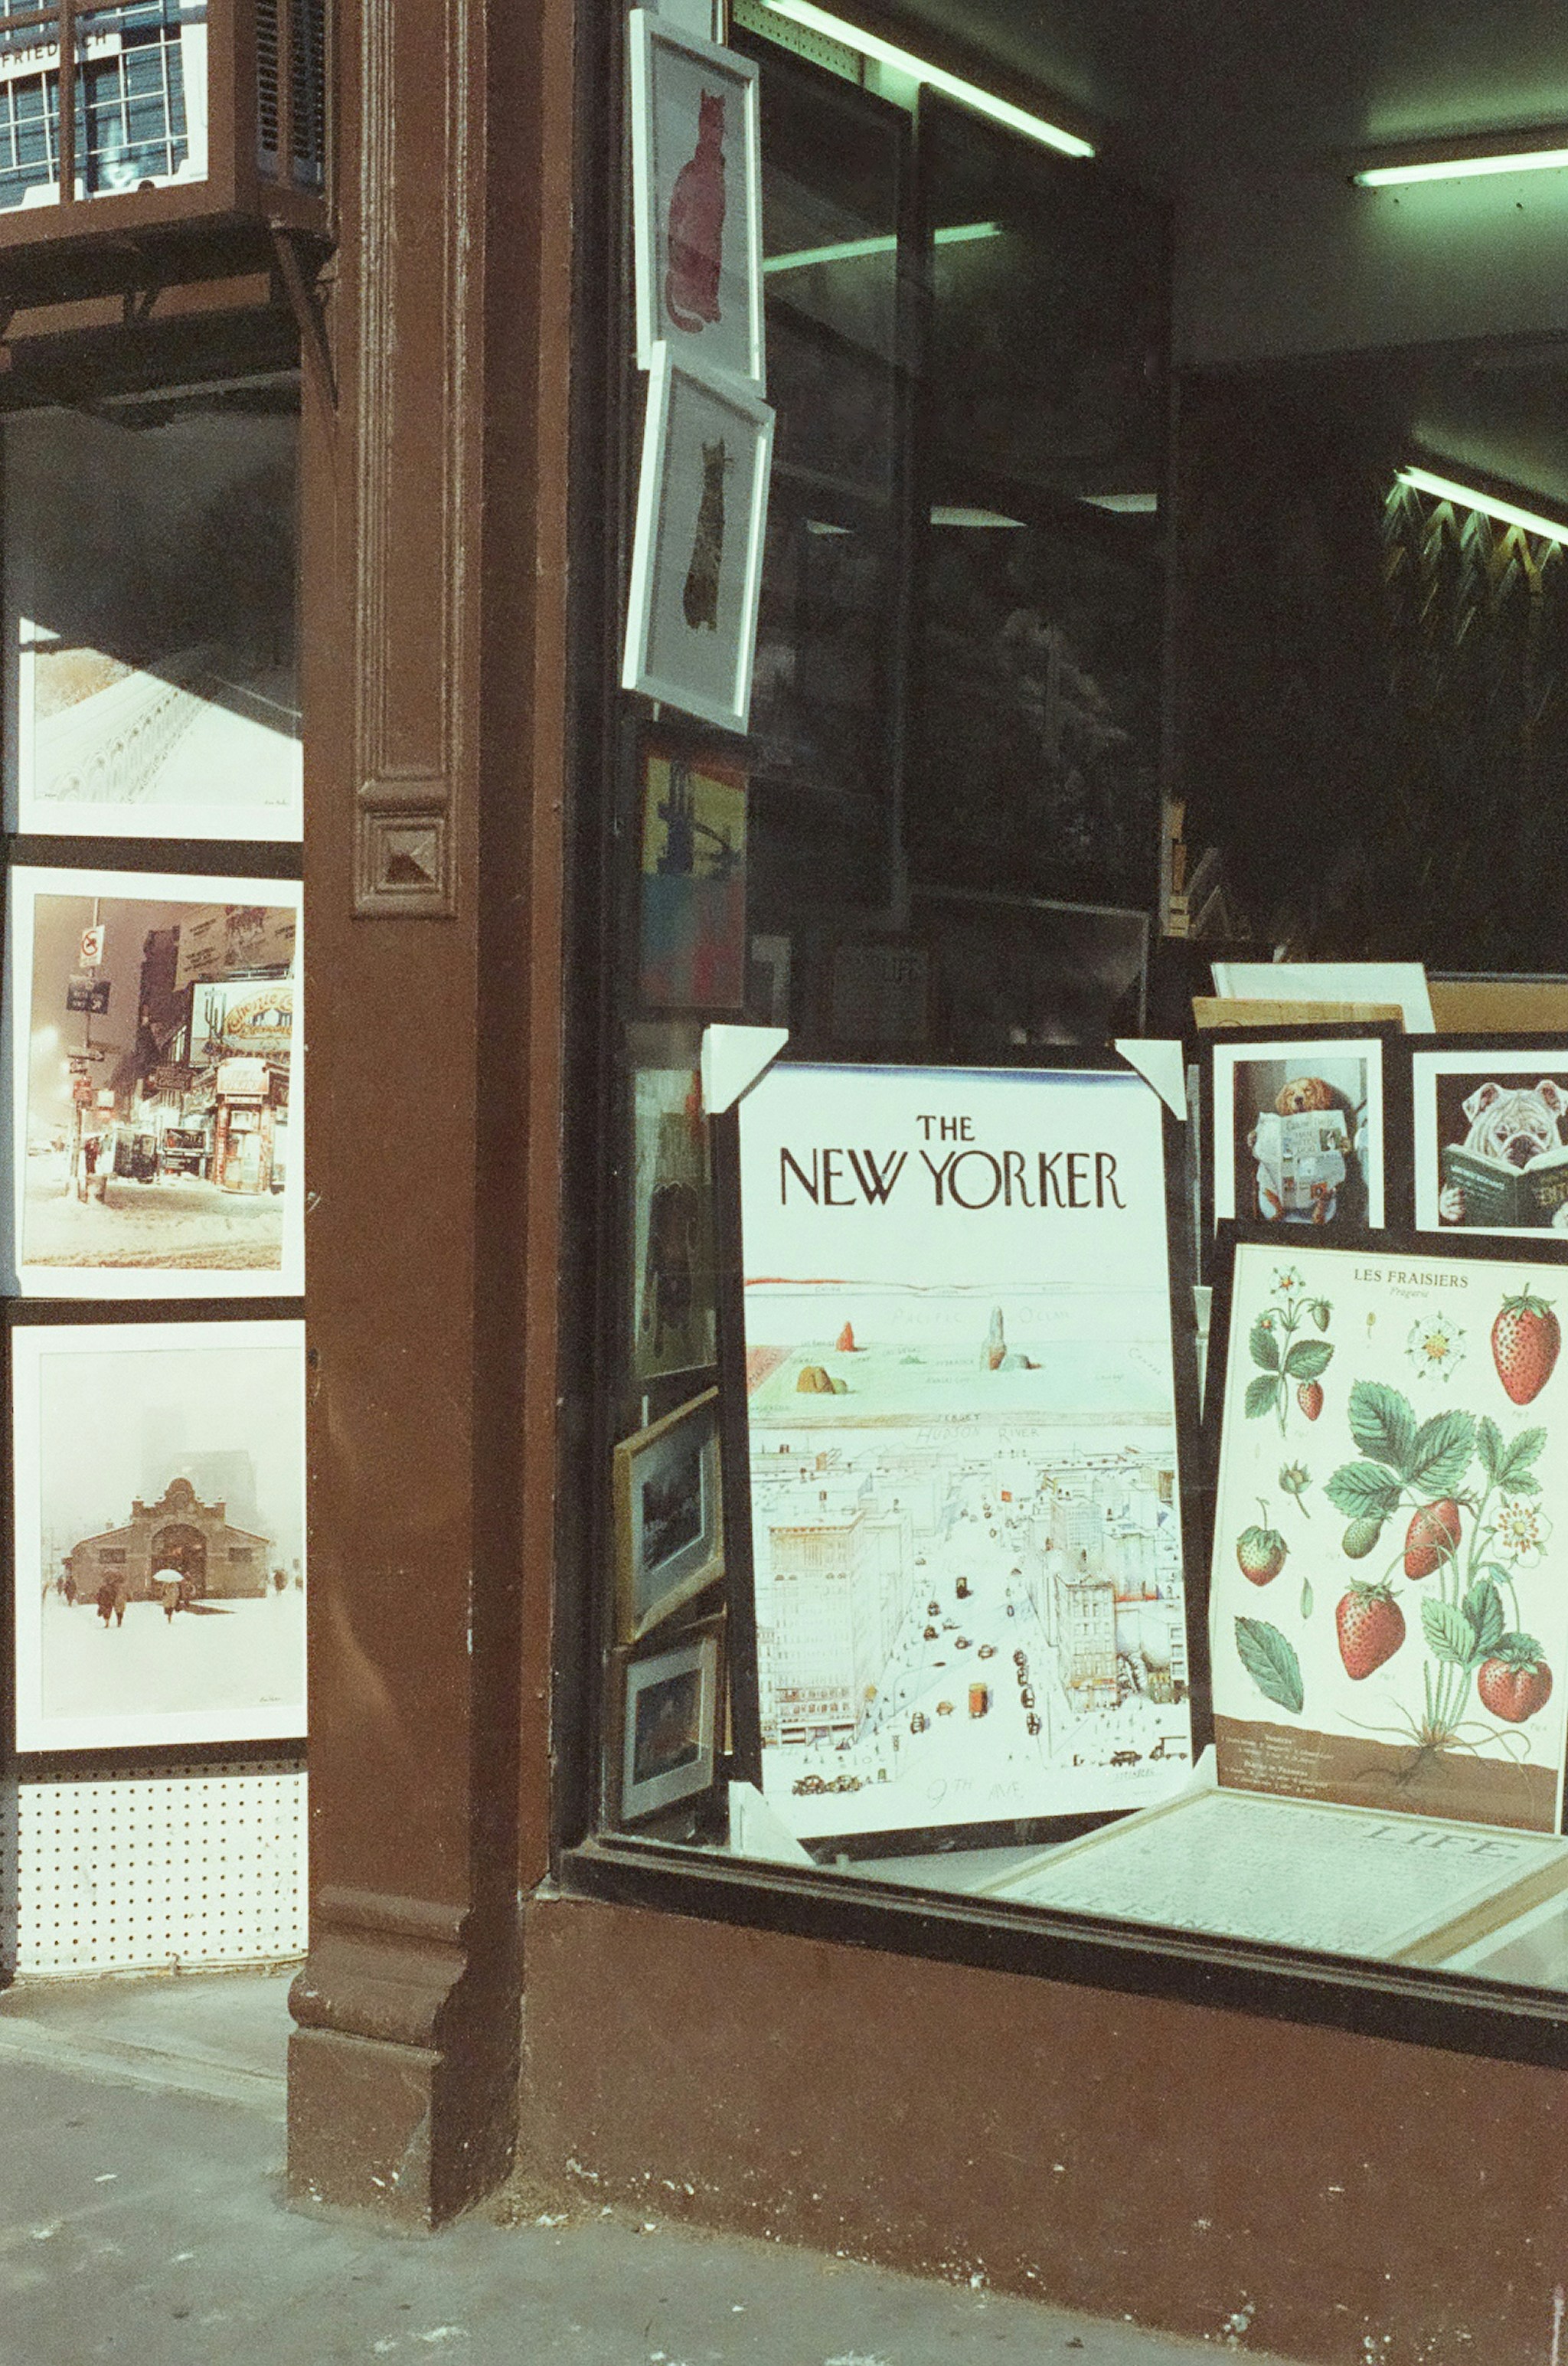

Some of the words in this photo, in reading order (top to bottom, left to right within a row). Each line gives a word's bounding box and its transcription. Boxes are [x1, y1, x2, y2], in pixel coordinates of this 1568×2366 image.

[2, 33, 106, 67] FRIEDCH
[916, 1114, 976, 1142] THE
[779, 1146, 908, 1207] NEW
[919, 1149, 1127, 1209] YORKER
[1354, 1268, 1383, 1282] LES
[1387, 1270, 1469, 1289] FRAISIERS
[891, 1306, 963, 1325] PACIFIC
[1019, 1306, 1070, 1323] OCEAN
[915, 1426, 980, 1444] HUDSON
[998, 1426, 1040, 1444] RIVER
[1364, 1825, 1520, 1861] LIFE.
